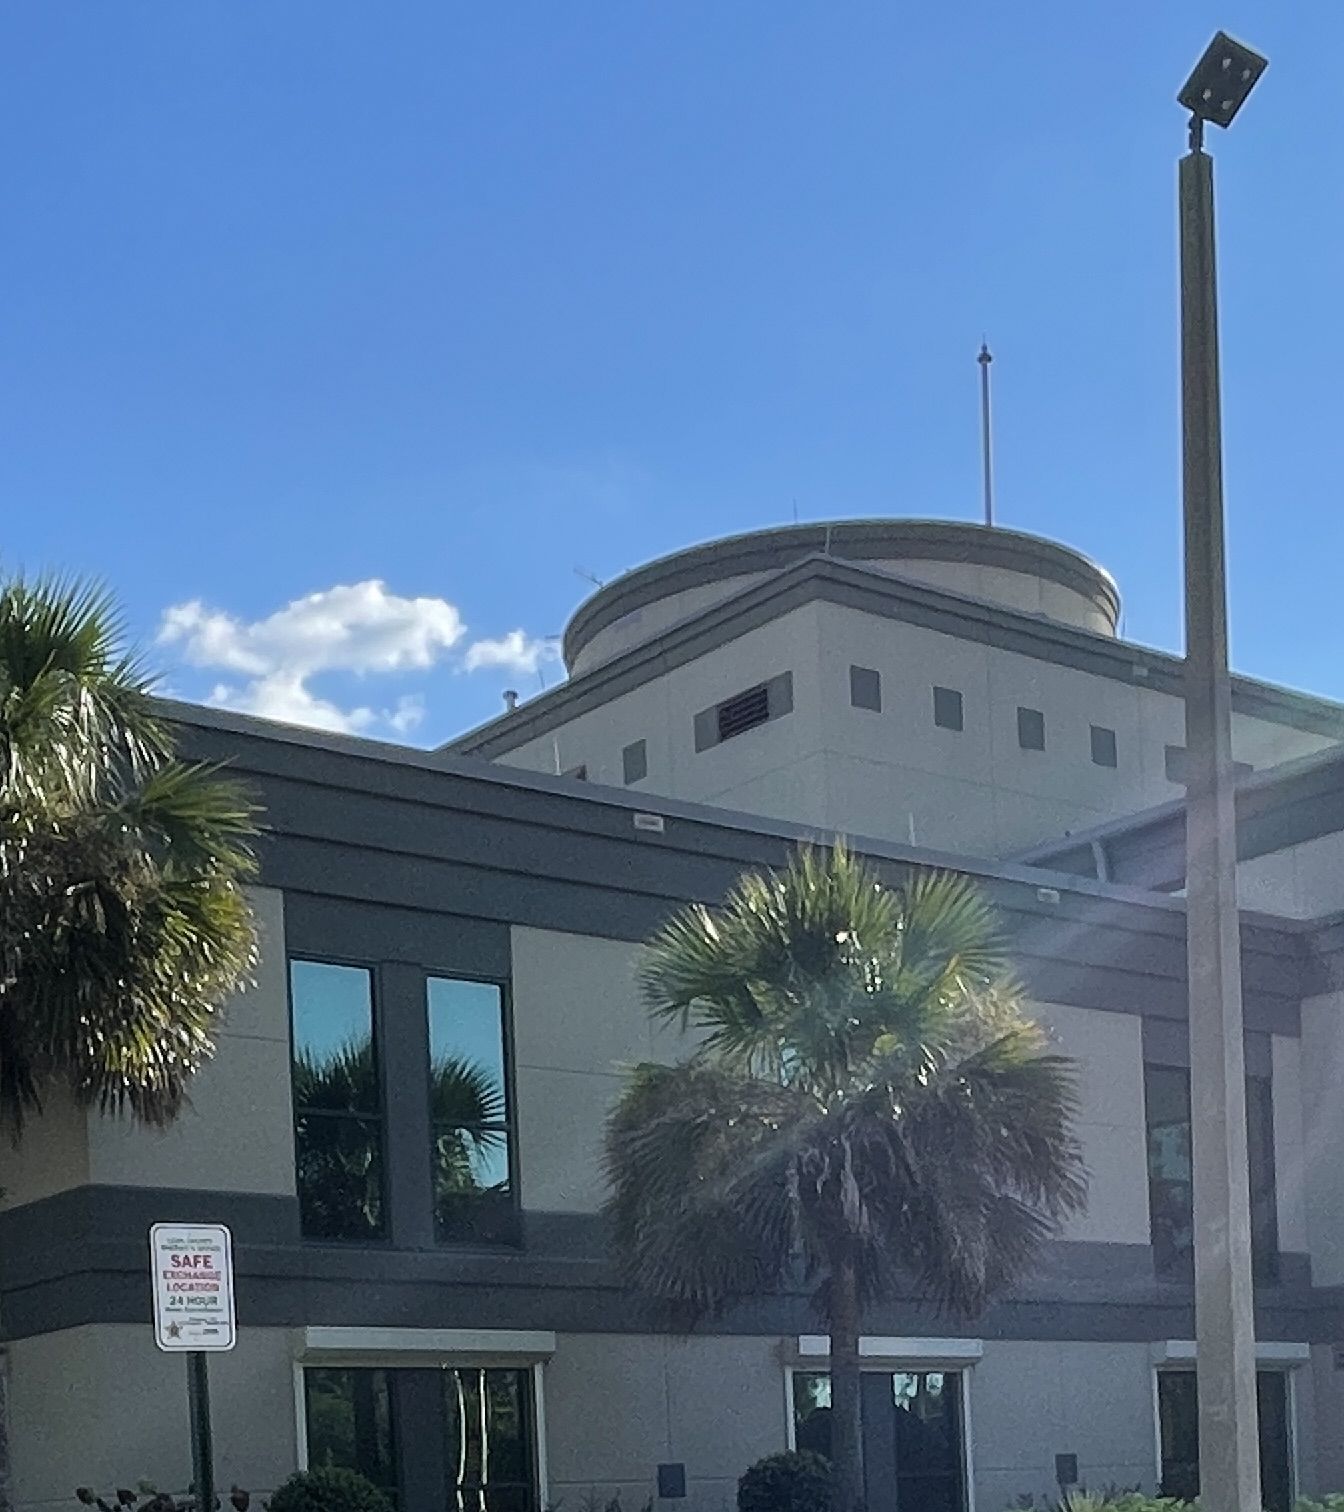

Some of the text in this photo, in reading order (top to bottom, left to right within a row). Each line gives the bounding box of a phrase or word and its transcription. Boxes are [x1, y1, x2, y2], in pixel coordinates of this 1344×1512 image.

[171, 1255, 213, 1269] SAFE
[167, 1283, 219, 1291] LOCATION
[169, 1296, 217, 1305] 24 HOUR
